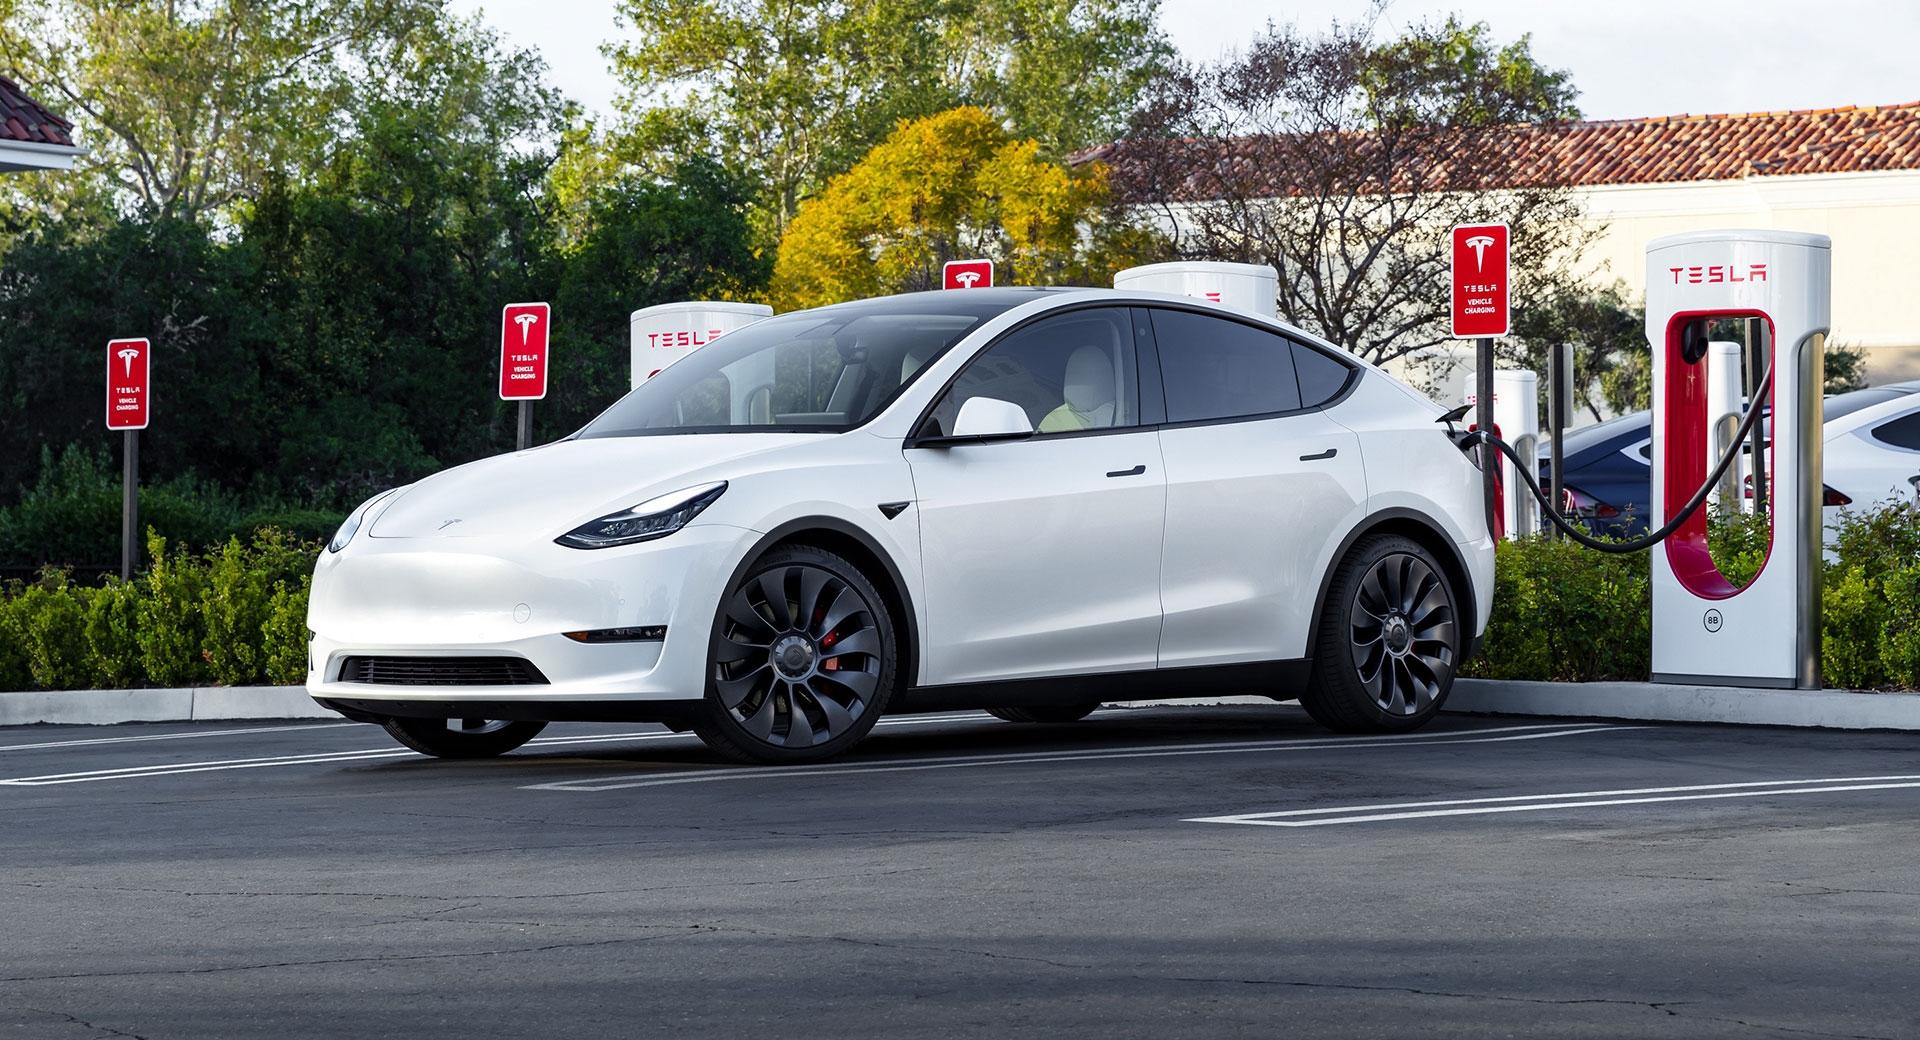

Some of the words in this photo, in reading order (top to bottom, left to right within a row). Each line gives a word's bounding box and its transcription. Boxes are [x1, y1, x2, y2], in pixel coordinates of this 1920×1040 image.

[1669, 264, 1767, 285] TESLA
[1463, 284, 1497, 293] TESLA
[1467, 297, 1493, 306] VEHICLE
[1464, 306, 1496, 315] CHARGING
[510, 354, 538, 362] TESLA
[115, 386, 141, 394] TESLA
